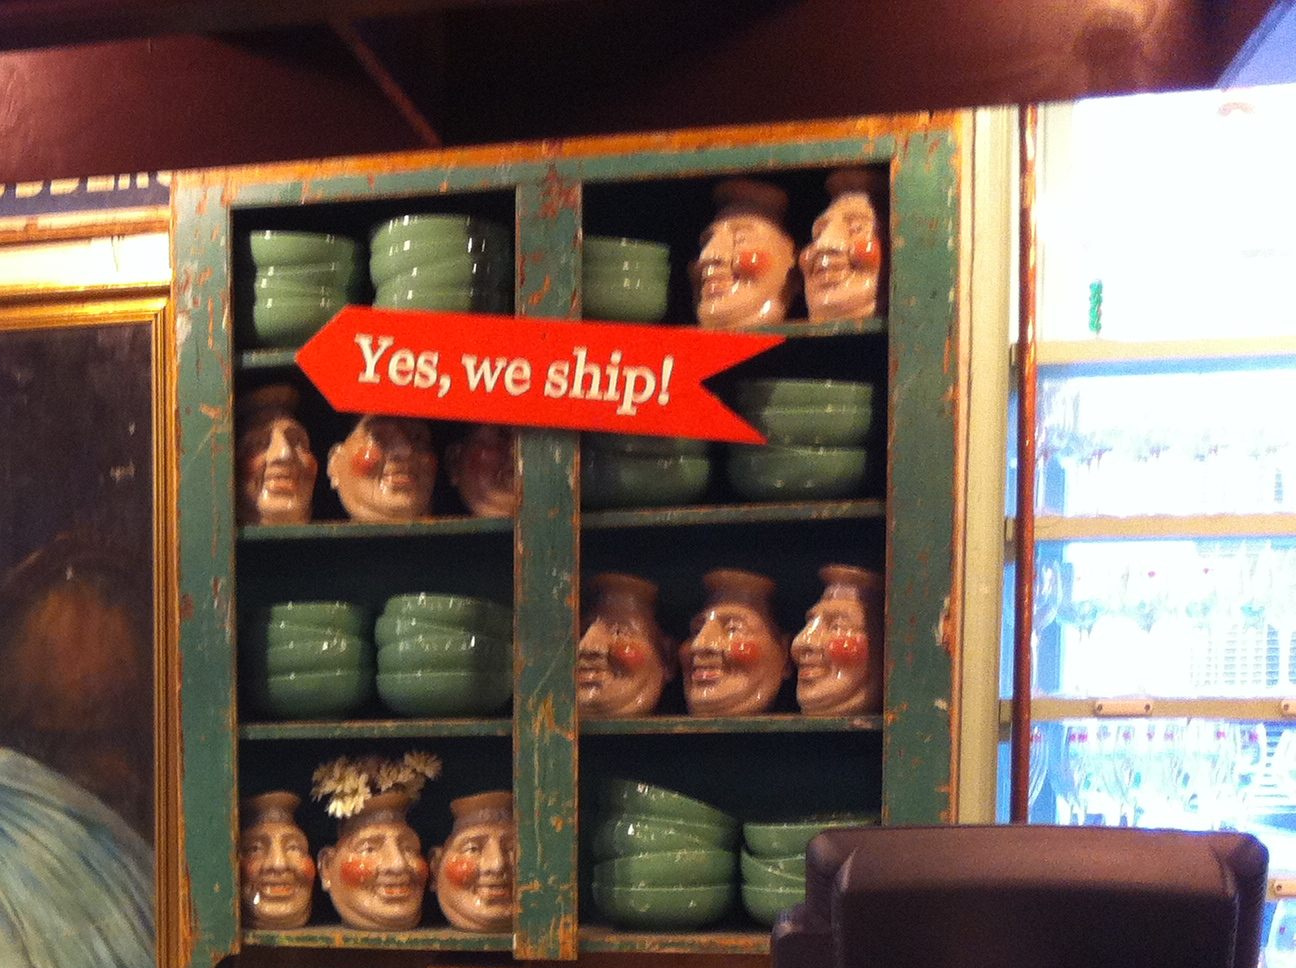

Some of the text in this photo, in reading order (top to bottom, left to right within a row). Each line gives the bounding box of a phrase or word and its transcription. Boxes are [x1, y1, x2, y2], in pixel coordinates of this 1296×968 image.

[353, 333, 674, 416] Yes, we ship!
